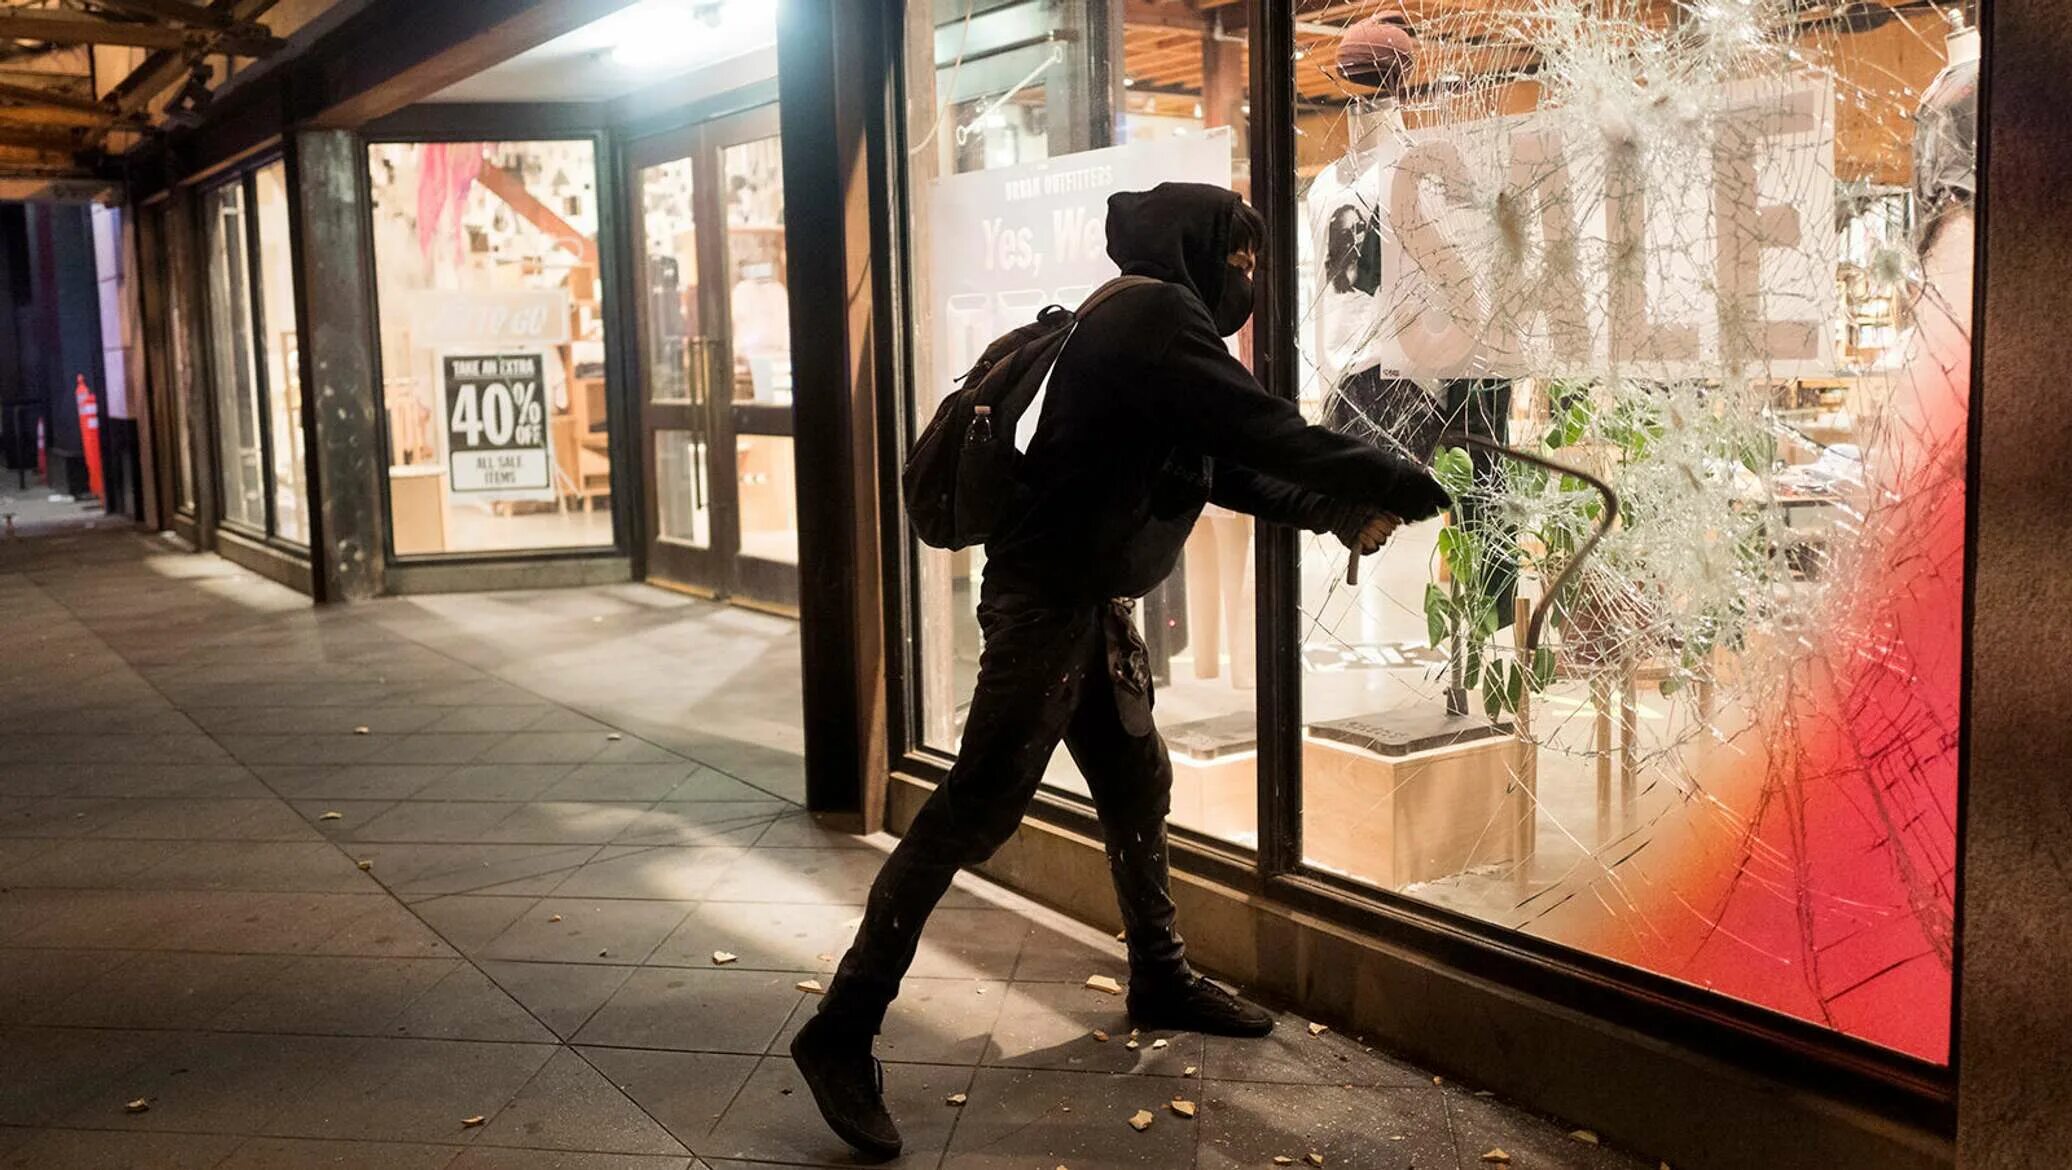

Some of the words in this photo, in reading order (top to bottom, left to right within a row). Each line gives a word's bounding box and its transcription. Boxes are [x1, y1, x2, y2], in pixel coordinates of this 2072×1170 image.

[1044, 164, 1113, 196] OUTFITTERS
[982, 217, 1042, 279] Yes,
[1052, 206, 1103, 264] We
[1391, 89, 1820, 374] SALE
[452, 360, 480, 377] TAKE
[499, 358, 534, 376] EXTRA
[451, 381, 541, 447] 40%
[515, 424, 541, 445] OFF
[476, 457, 493, 469] ALL
[497, 456, 522, 468] SALE
[484, 471, 516, 483] ITEMS
